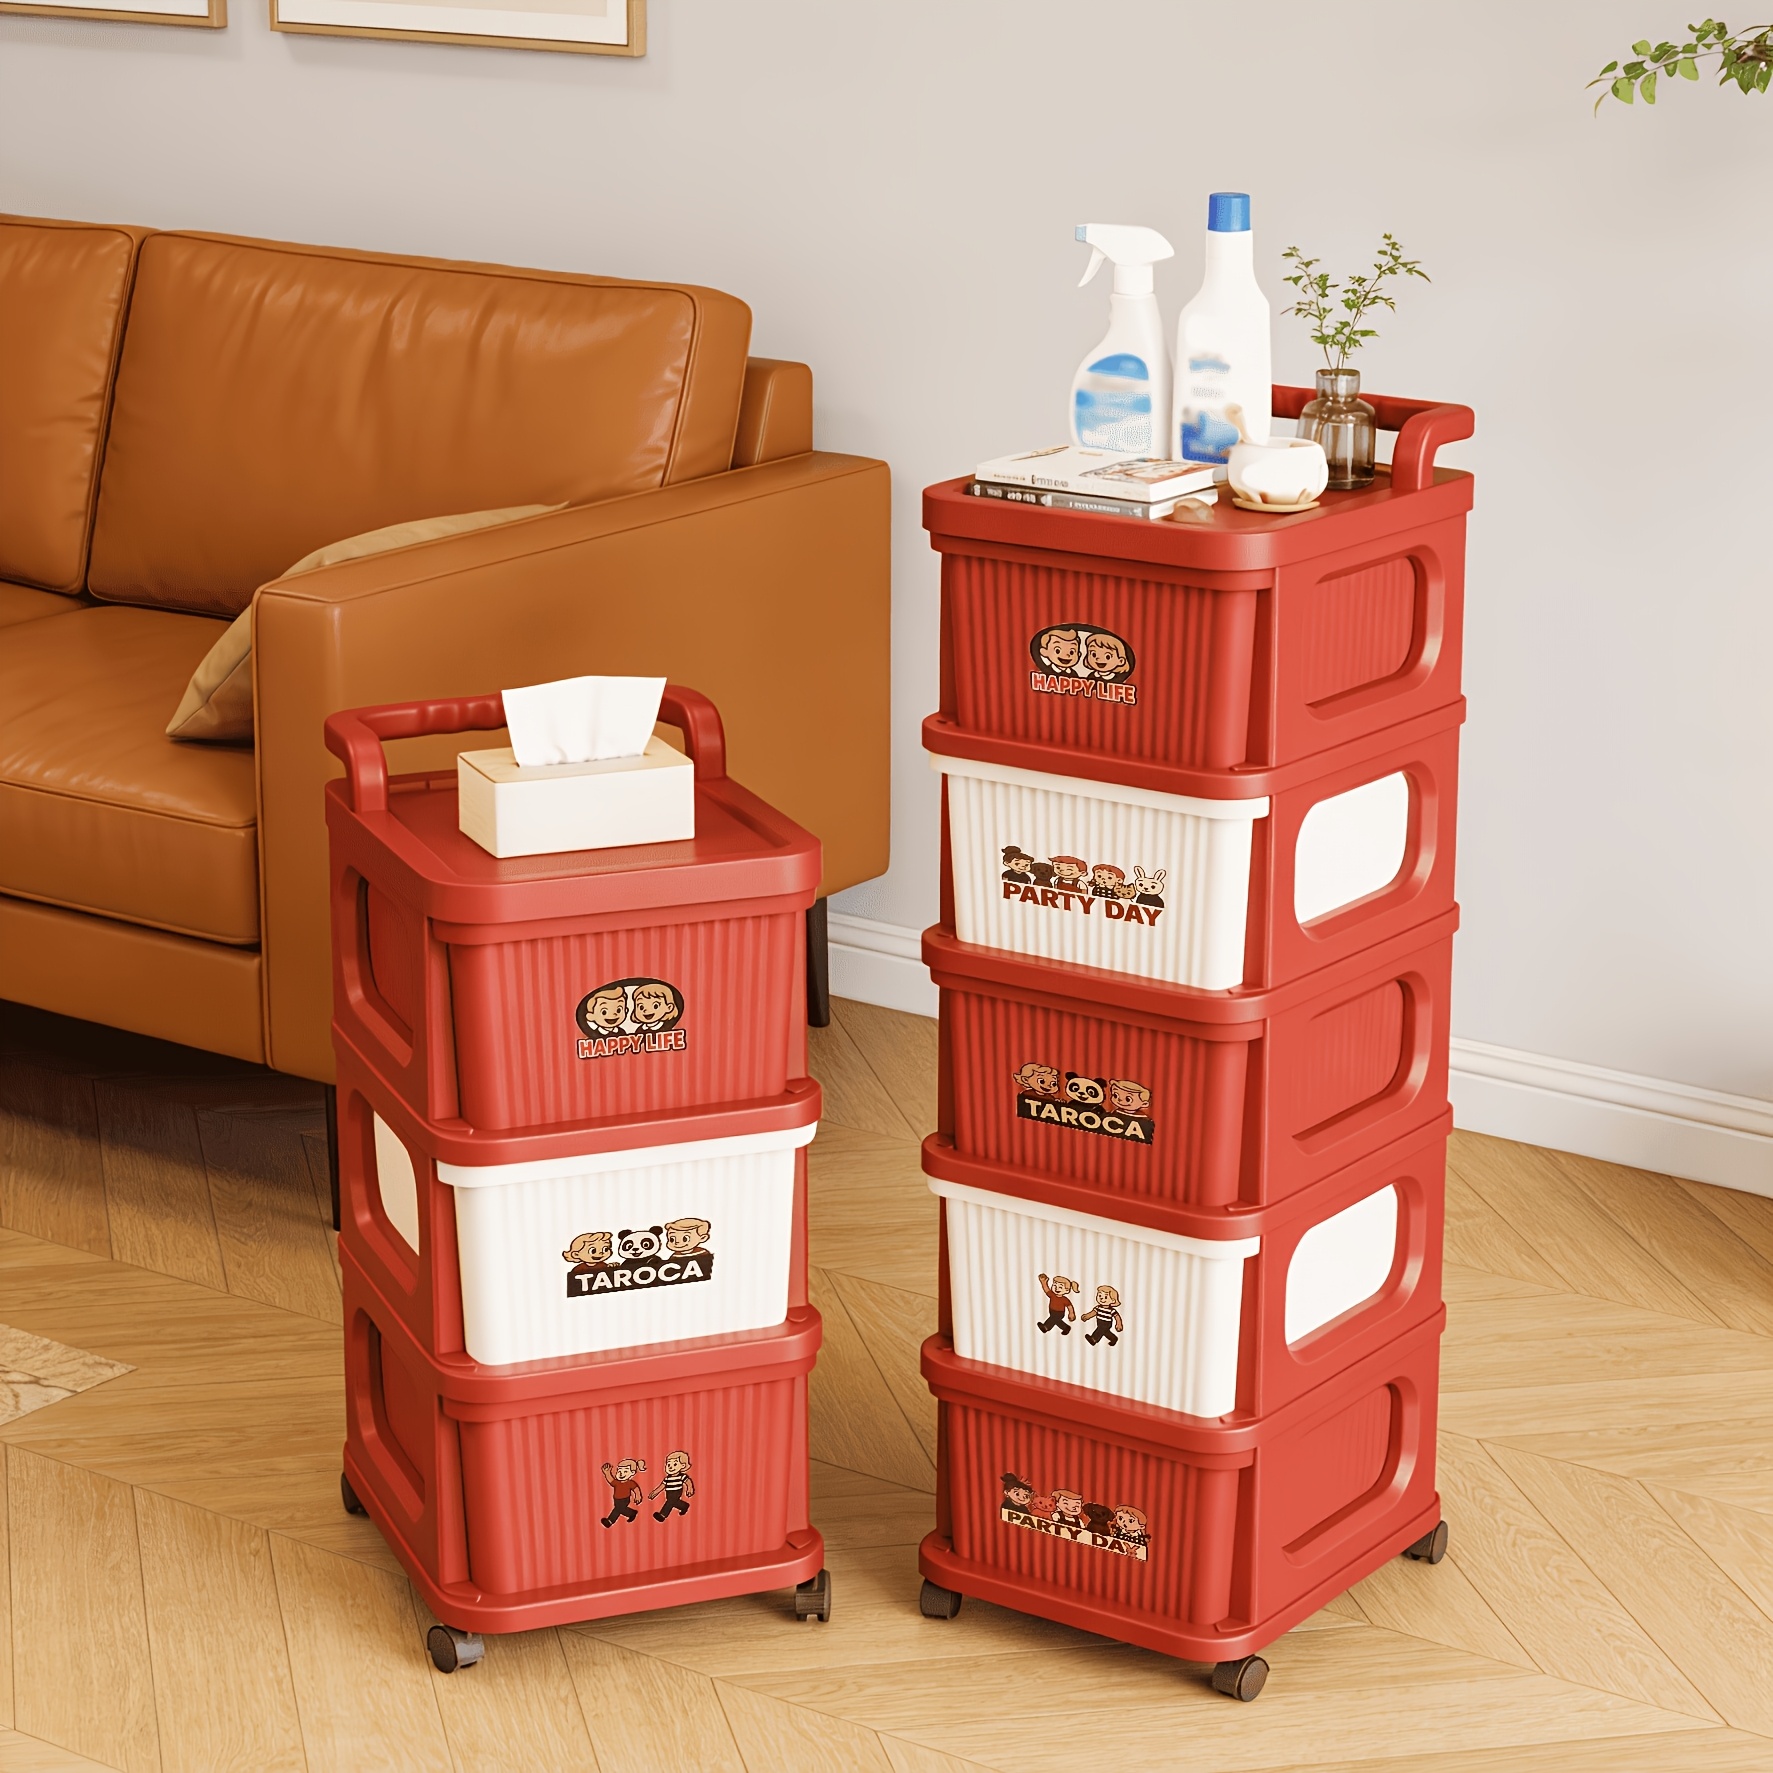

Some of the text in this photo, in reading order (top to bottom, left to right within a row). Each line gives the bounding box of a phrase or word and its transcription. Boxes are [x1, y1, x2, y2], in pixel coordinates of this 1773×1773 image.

[1031, 672, 1136, 704] HAPPY LIFE
[1002, 882, 1162, 927] PARTY DAY
[578, 1030, 686, 1058] HAPPY LIFE
[1025, 1099, 1145, 1139] TAROCA
[574, 1260, 703, 1291] TAROCA
[1007, 1511, 1140, 1558] PARTY DAY
